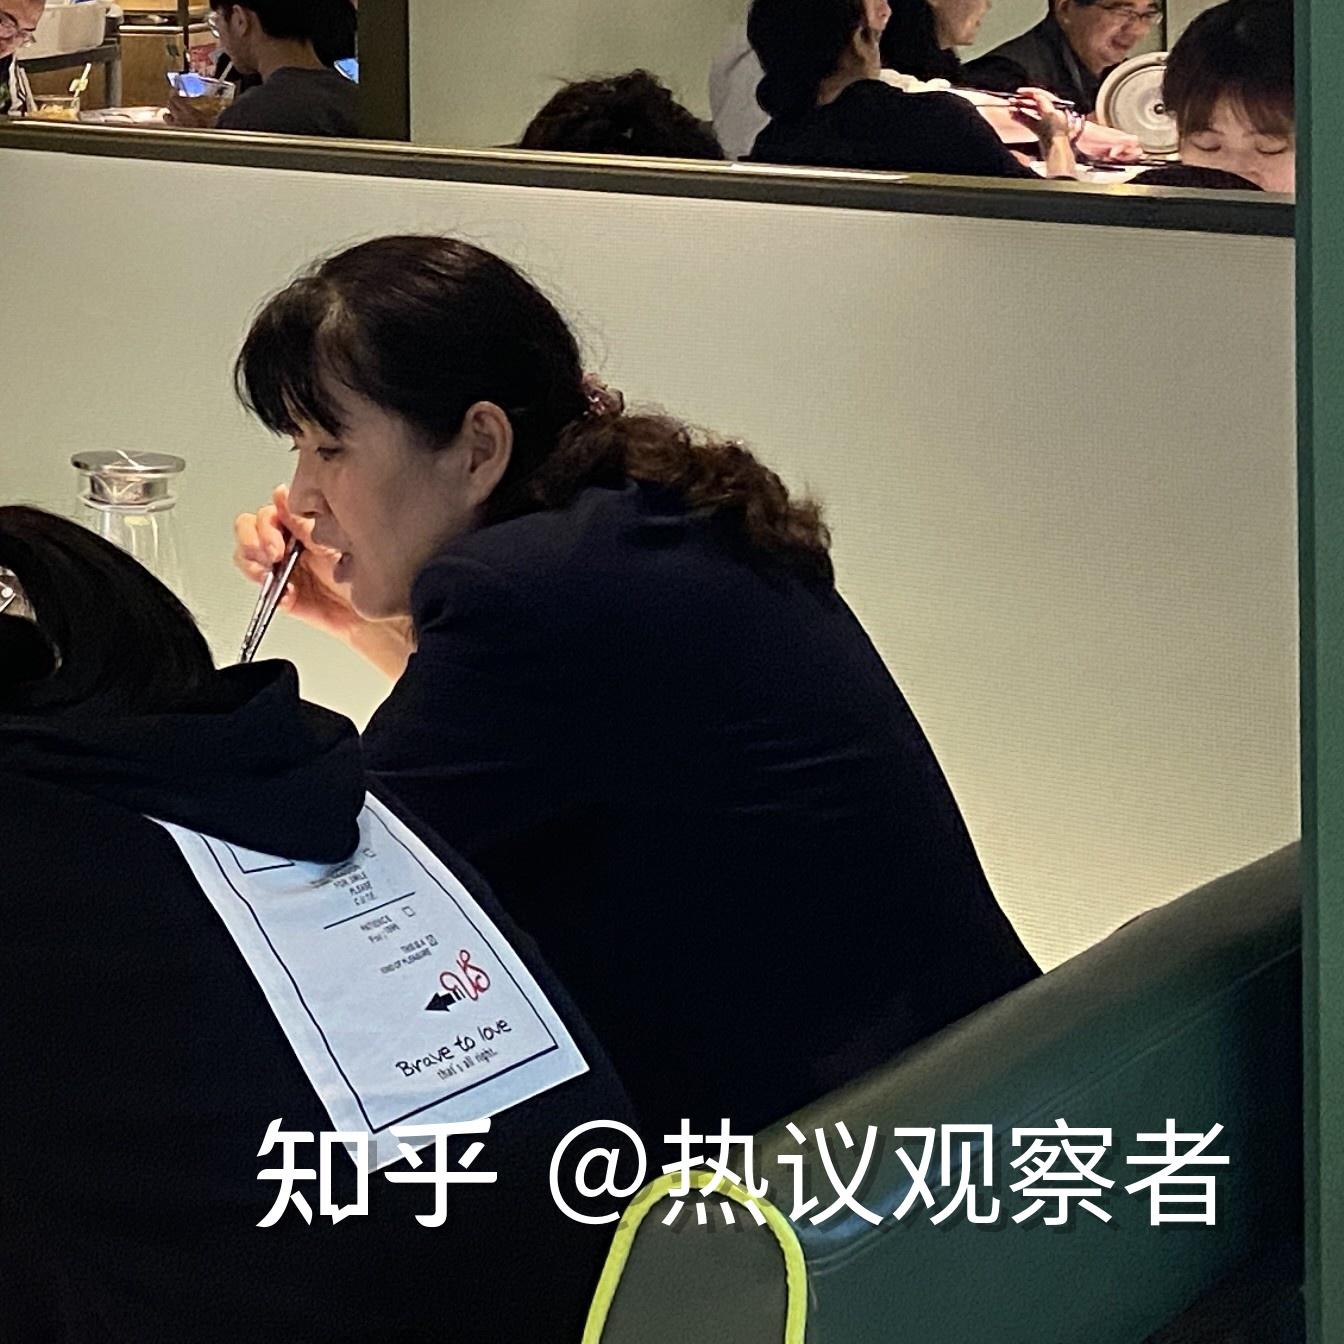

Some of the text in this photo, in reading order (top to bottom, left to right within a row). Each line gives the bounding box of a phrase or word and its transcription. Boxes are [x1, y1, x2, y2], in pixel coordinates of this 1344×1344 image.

[395, 1019, 512, 1077] Brave to love
